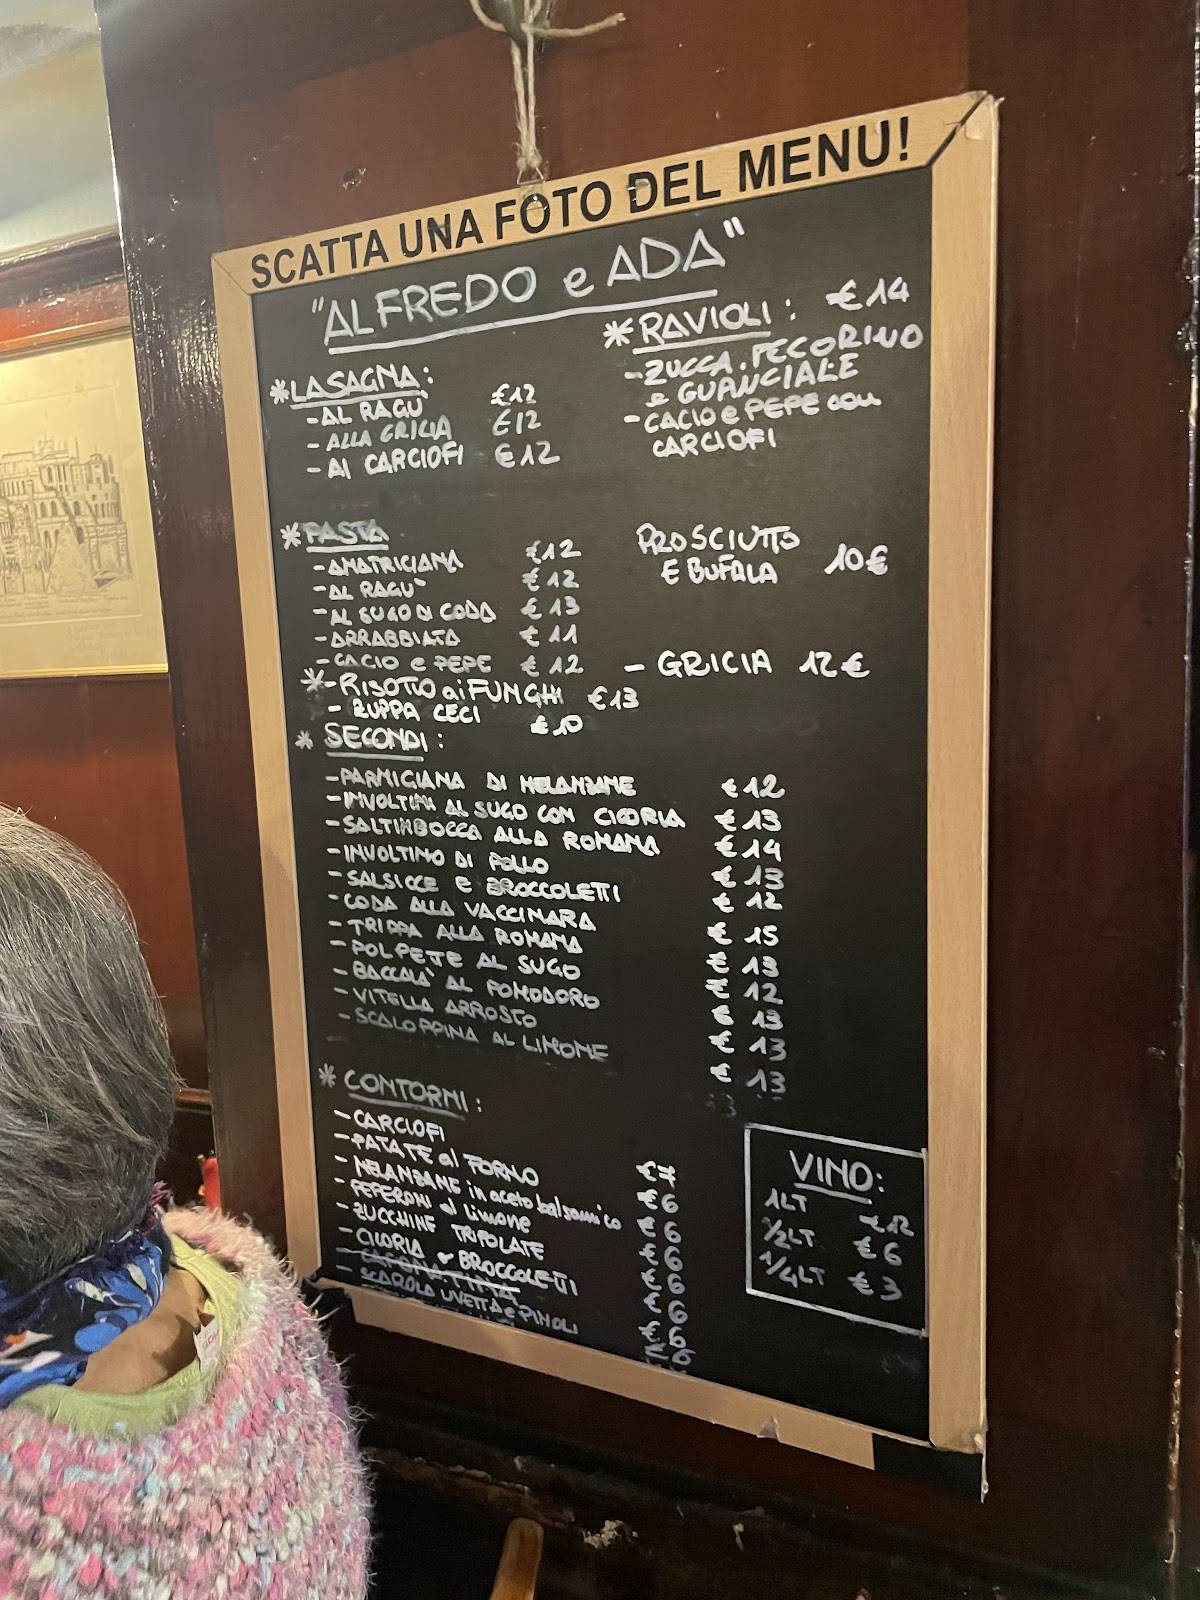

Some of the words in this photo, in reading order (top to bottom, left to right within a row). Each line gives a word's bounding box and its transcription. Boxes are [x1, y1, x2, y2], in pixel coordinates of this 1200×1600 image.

[250, 228, 389, 289] SCATTA
[399, 208, 484, 260] UNA
[496, 181, 612, 241] FOTO
[627, 160, 722, 214] DEL
[739, 116, 910, 193] MENU!
[563, 267, 595, 298] e
[753, 323, 924, 369] PECORINO
[677, 353, 859, 405] GUANCIALE
[321, 405, 353, 426] AL
[644, 405, 717, 434] CACIO
[744, 392, 820, 421] PEPE
[326, 432, 372, 452] ALLA
[380, 415, 453, 444] GRICIA
[653, 428, 777, 458] CARCIOFI
[327, 458, 352, 481] AI
[365, 441, 464, 475] CARCIOFI
[302, 519, 390, 544] PASTA
[636, 522, 801, 555] PROSCIUTTO
[328, 549, 464, 577] AMATRICIANA
[687, 554, 779, 585] BUFALA
[328, 584, 354, 600] AL
[330, 607, 353, 626] AL
[360, 603, 412, 624] SUGO
[440, 599, 498, 624] CODA
[330, 628, 461, 649] ARRABBIATA
[334, 653, 400, 670] CACIO
[434, 654, 492, 674] PEPE
[657, 648, 773, 678] GRICIA
[340, 672, 437, 699] RISOTTO
[467, 679, 564, 706] FUNGHI
[433, 699, 481, 723] CECI
[486, 771, 508, 791] DI
[445, 798, 469, 818] AL
[473, 800, 528, 820] SUGO
[537, 804, 576, 824] CON
[343, 814, 483, 840] SALTIMBOCCA
[494, 825, 549, 847] ALLA
[562, 830, 660, 856] ROMANA
[343, 843, 445, 867] INVOLTINO
[455, 850, 474, 868] DI
[488, 851, 549, 875] POLLO
[347, 869, 439, 893] SALSICCE
[486, 876, 621, 903] BROCCOLETTI
[344, 892, 398, 913] CODA
[409, 895, 455, 918] ALLA
[464, 901, 597, 931] VACCINARA
[347, 916, 423, 938] TRIPPA
[436, 923, 485, 941] ALLA
[494, 926, 584, 954] ROMANA
[476, 952, 508, 971] AL
[518, 954, 581, 980] SUGO
[353, 987, 435, 1013] VITELLA
[444, 999, 538, 1029] ARROSTO
[445, 975, 474, 993] AL
[486, 979, 601, 1010] POMODORO
[355, 1007, 480, 1044] SCALOPPINA
[492, 1032, 516, 1047] AL
[522, 1034, 609, 1061] LIMONE
[353, 1108, 446, 1142] CARCIOFI
[350, 1132, 434, 1165] PATATE
[462, 1153, 540, 1187] FORNO
[466, 1179, 488, 1202] in
[352, 1201, 437, 1234] ZUCCHINE
[463, 1203, 532, 1234] limone
